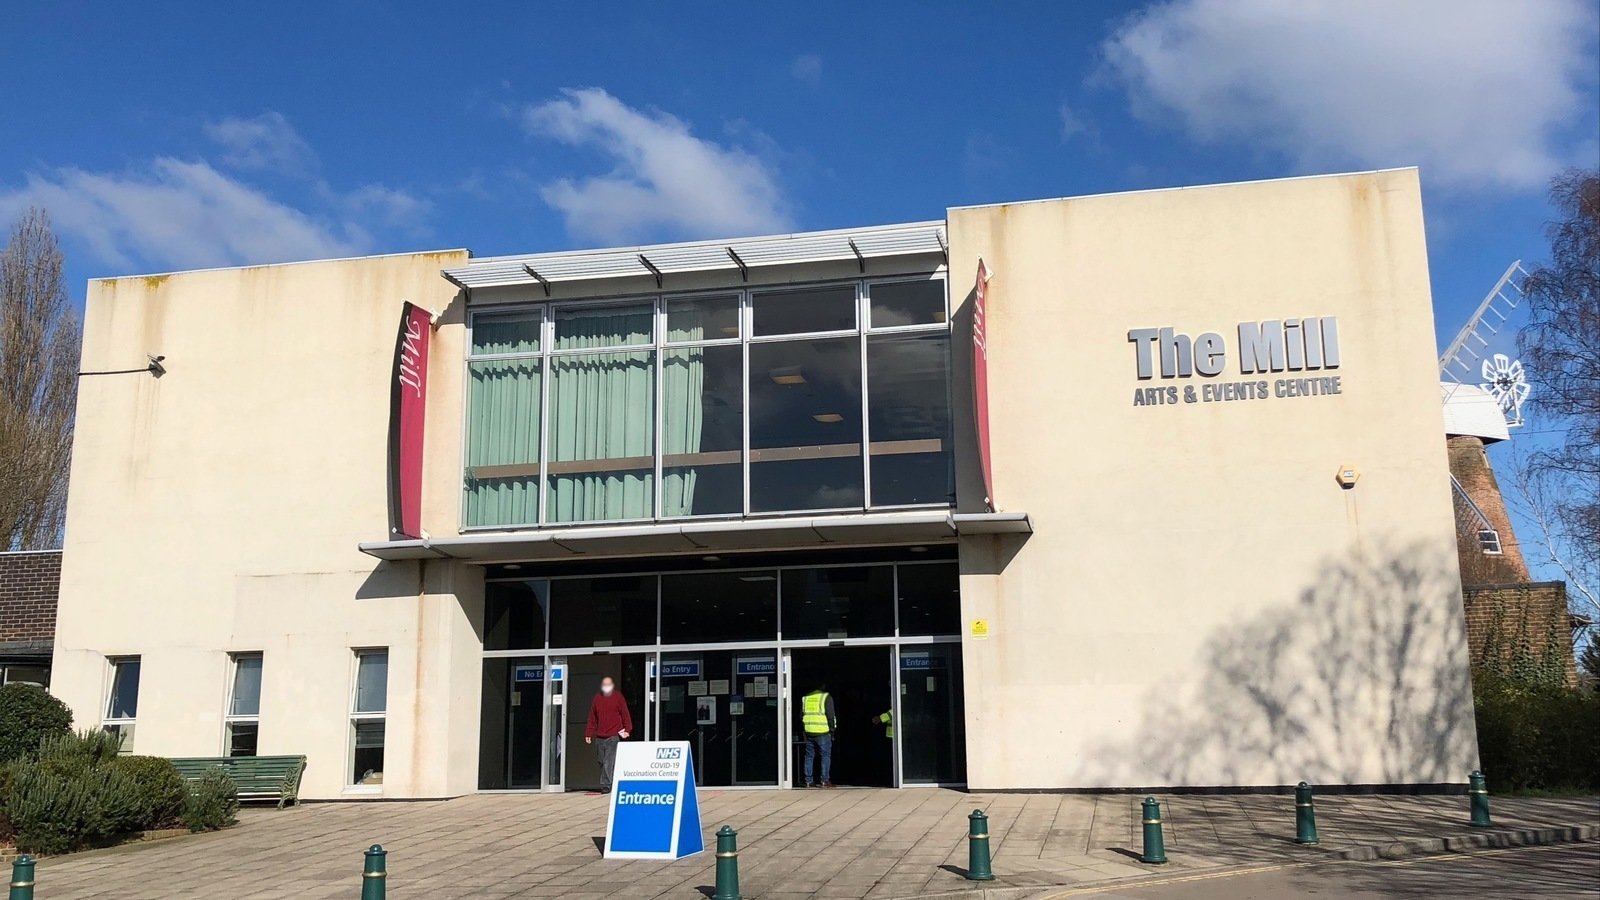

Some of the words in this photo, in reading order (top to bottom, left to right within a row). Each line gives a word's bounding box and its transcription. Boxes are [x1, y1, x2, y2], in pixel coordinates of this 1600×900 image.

[1128, 327, 1226, 380] The
[1238, 317, 1340, 375] Mill
[399, 315, 421, 398] Mill
[1133, 385, 1178, 406] ARTS
[1184, 385, 1197, 403] &
[1202, 380, 1269, 402] EVENTS
[1274, 376, 1342, 399] CENTRE
[746, 663, 775, 672] Entranc
[906, 658, 937, 667] Entran
[672, 665, 691, 674] Entry
[657, 747, 681, 760] NHS
[617, 791, 675, 805] Entrance
